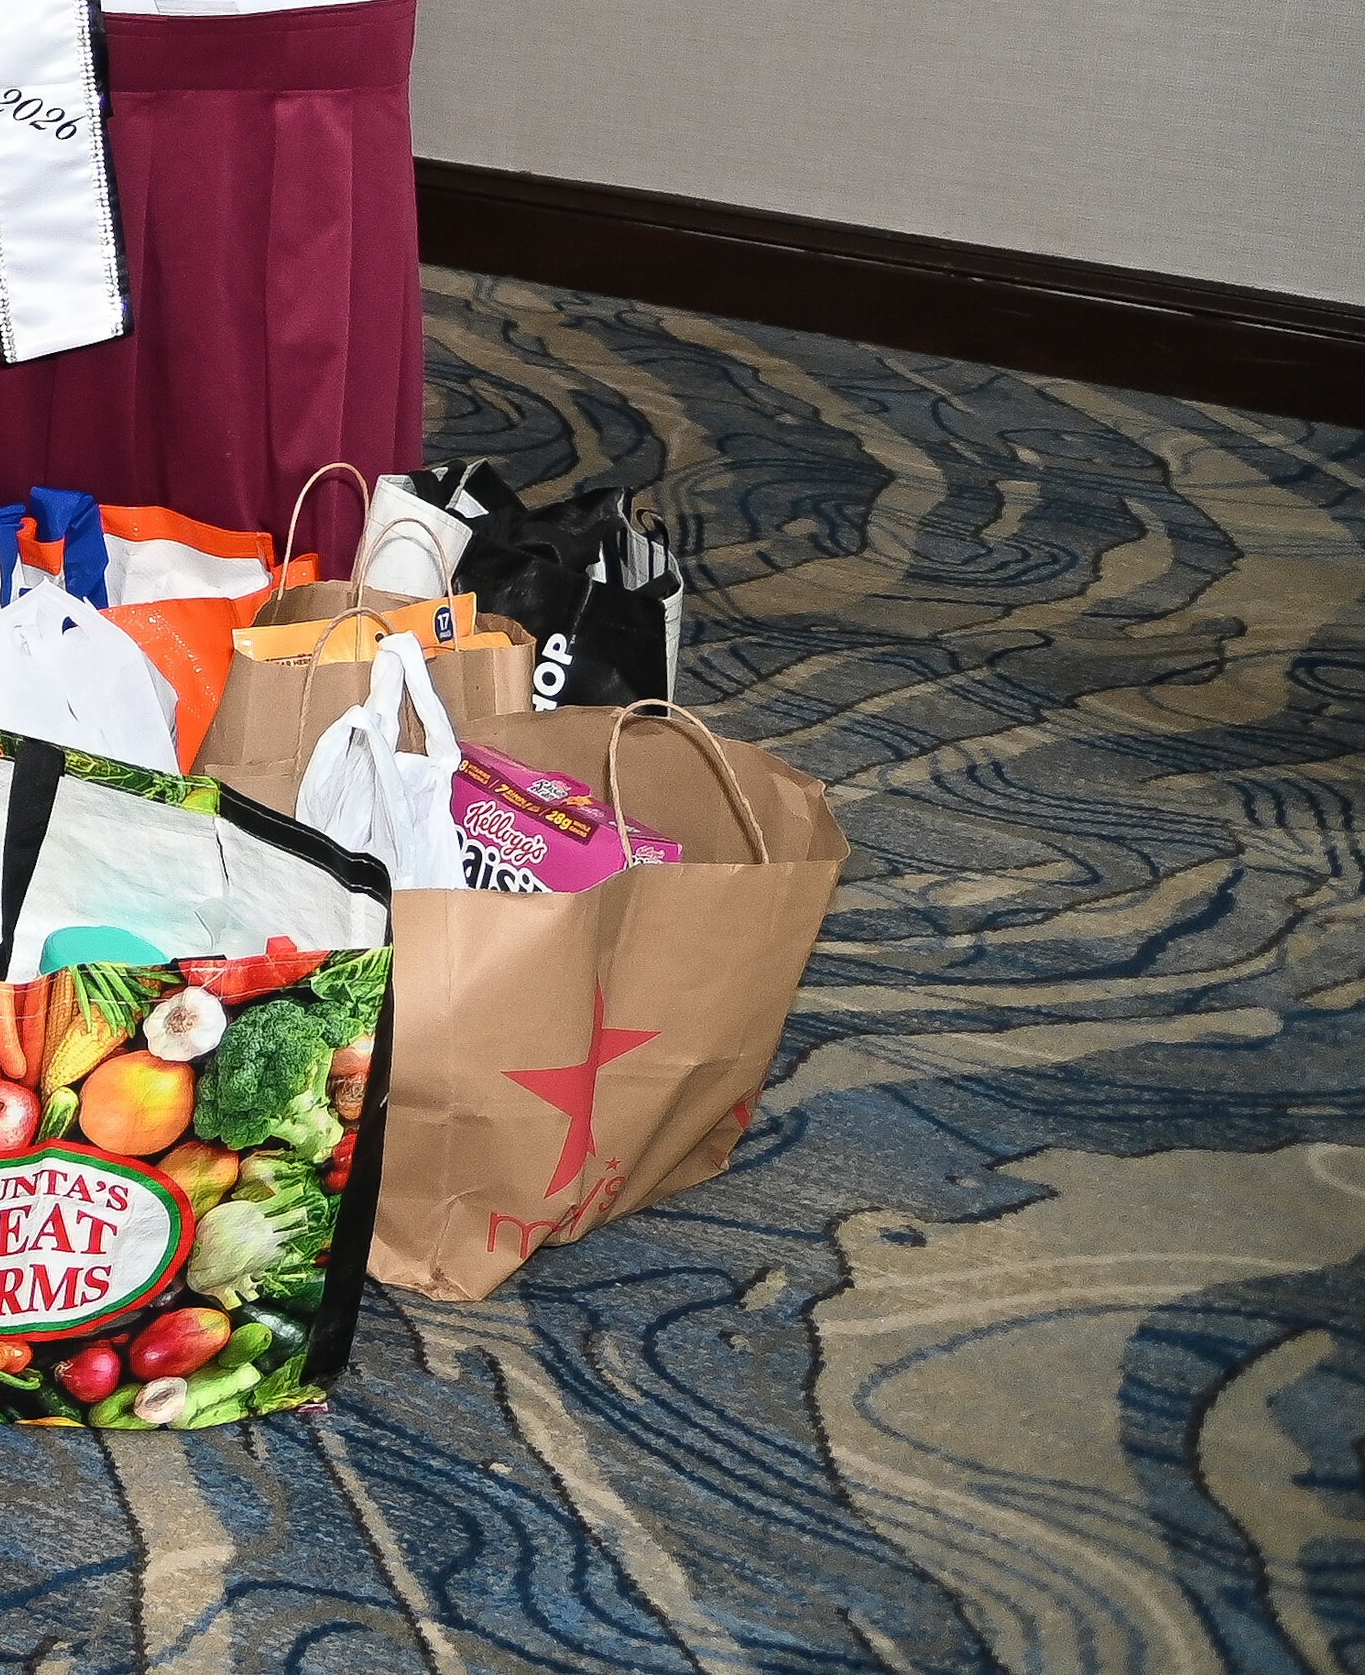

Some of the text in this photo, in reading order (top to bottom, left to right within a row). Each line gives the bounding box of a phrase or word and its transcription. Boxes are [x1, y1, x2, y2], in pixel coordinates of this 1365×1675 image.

[438, 613, 450, 630] 17
[532, 632, 573, 712] HOP
[465, 803, 547, 859] Kellogg's
[545, 810, 572, 830] 28g
